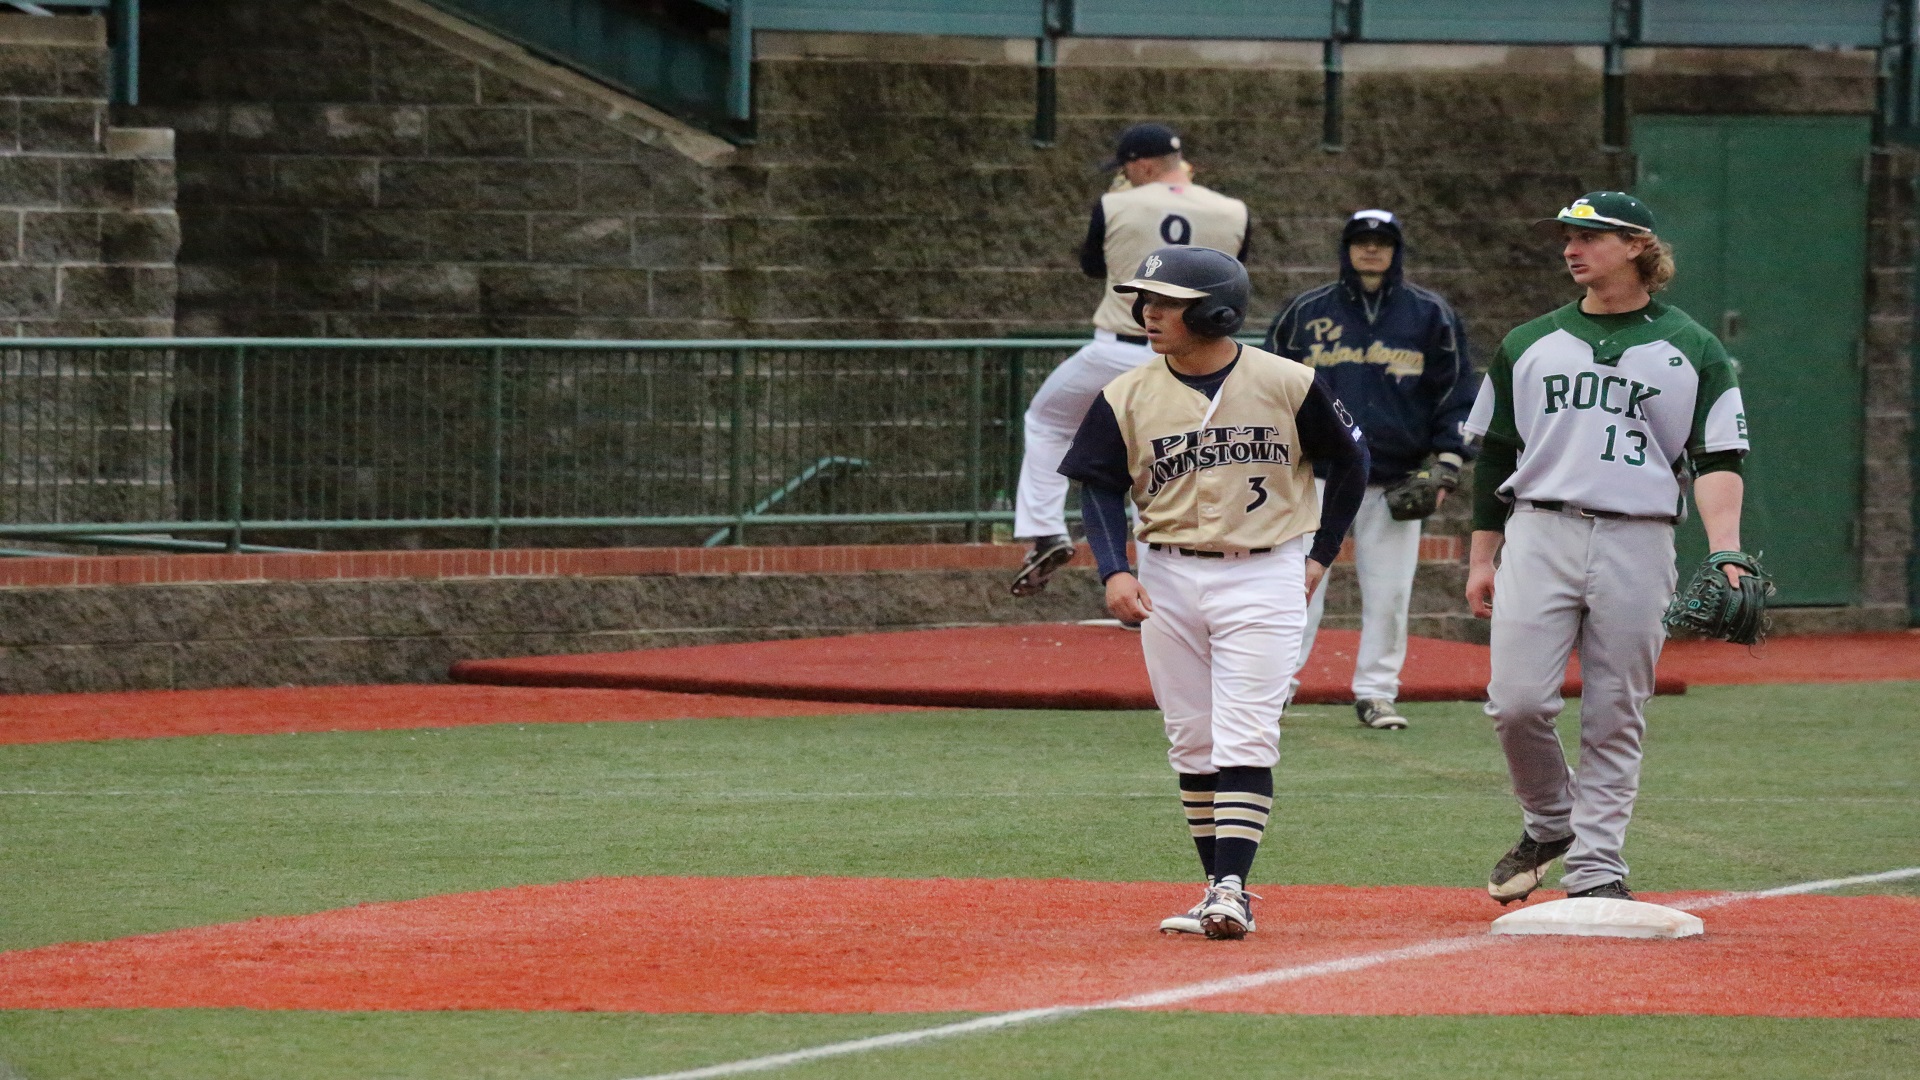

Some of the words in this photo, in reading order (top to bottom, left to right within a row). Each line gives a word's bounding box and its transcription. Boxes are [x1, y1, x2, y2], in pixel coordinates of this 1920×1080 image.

[1542, 371, 1662, 422] ROCK
[1149, 425, 1279, 460] PITT
[1600, 424, 1648, 467] 13
[1147, 441, 1292, 496] JOHNSTOWN
[1245, 475, 1268, 514] 3
